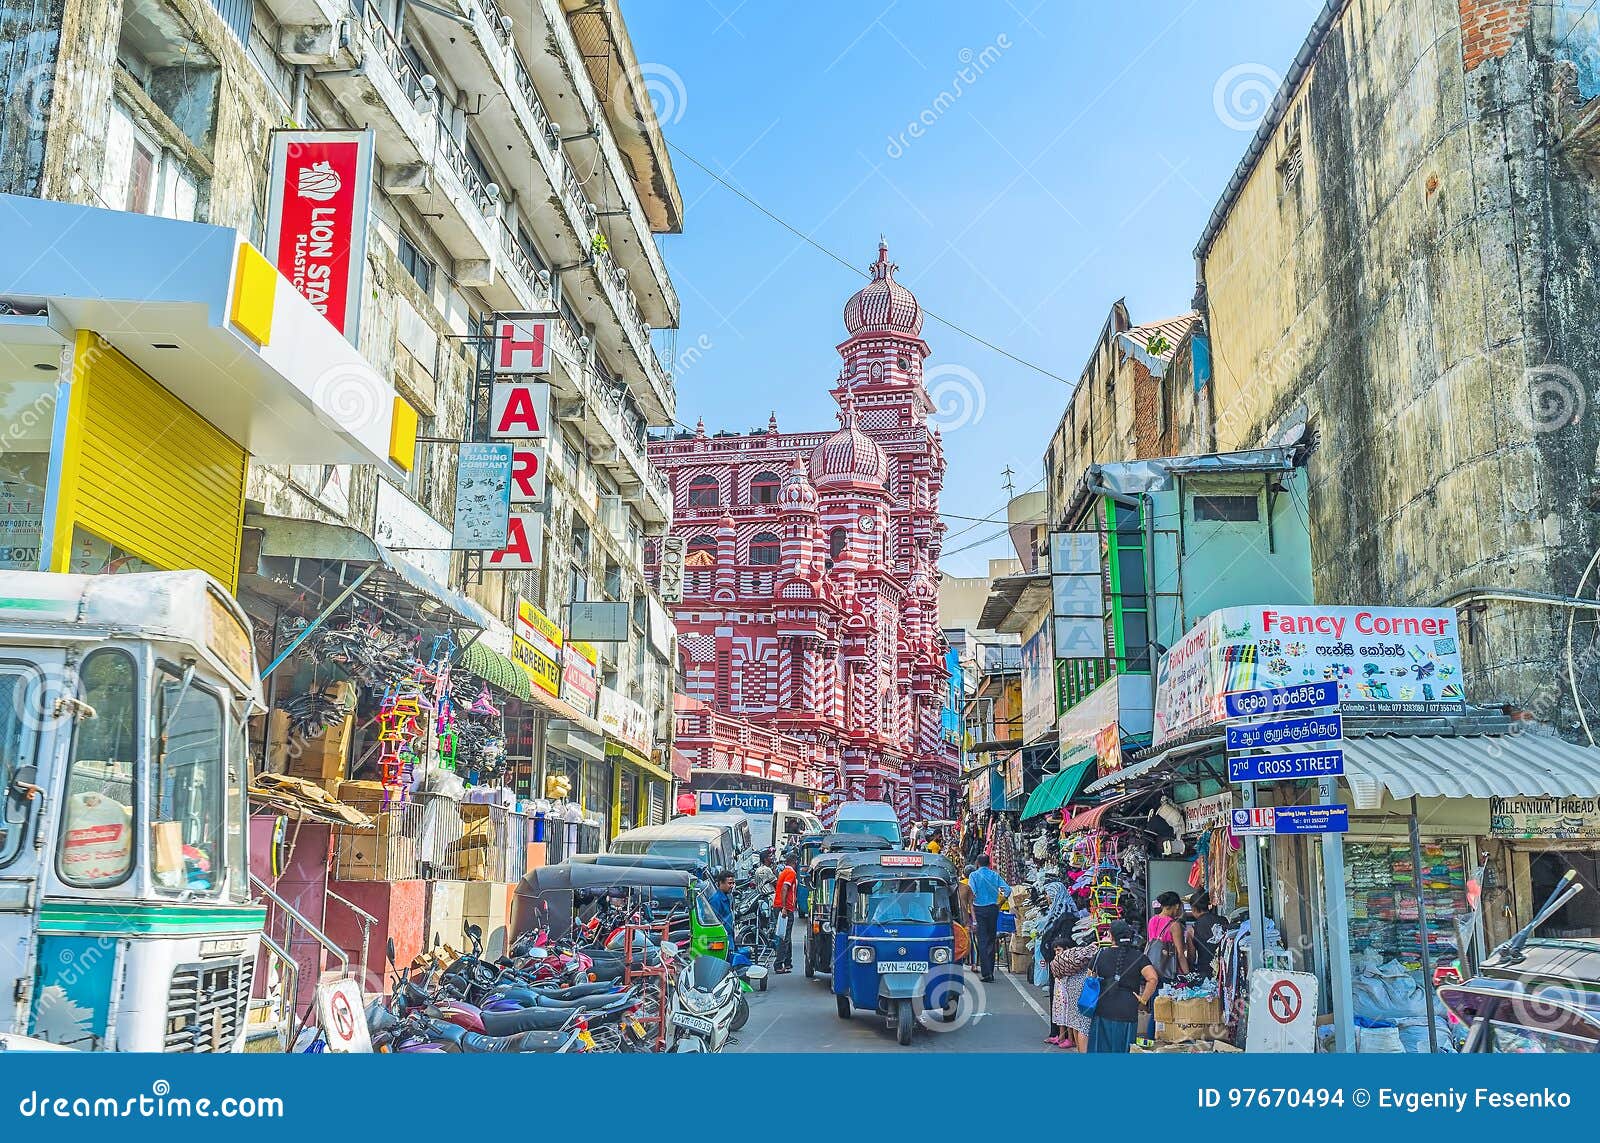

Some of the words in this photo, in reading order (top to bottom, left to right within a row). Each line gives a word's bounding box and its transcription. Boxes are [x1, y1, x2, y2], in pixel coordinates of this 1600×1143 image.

[309, 208, 337, 258] LION
[1262, 611, 1346, 640] Fancy
[1354, 612, 1450, 636] Corner
[514, 640, 546, 674] SABREEN
[1342, 703, 1365, 712] Colombo
[1231, 731, 1237, 743] 2
[1232, 759, 1249, 776] 2nd
[1257, 760, 1292, 774] CROSS
[1295, 756, 1339, 772] STREET
[715, 793, 769, 808] Verbatim
[1491, 796, 1552, 815] MILLENNIUM
[1553, 796, 1595, 814] THREAD
[1251, 808, 1274, 827] LIC
